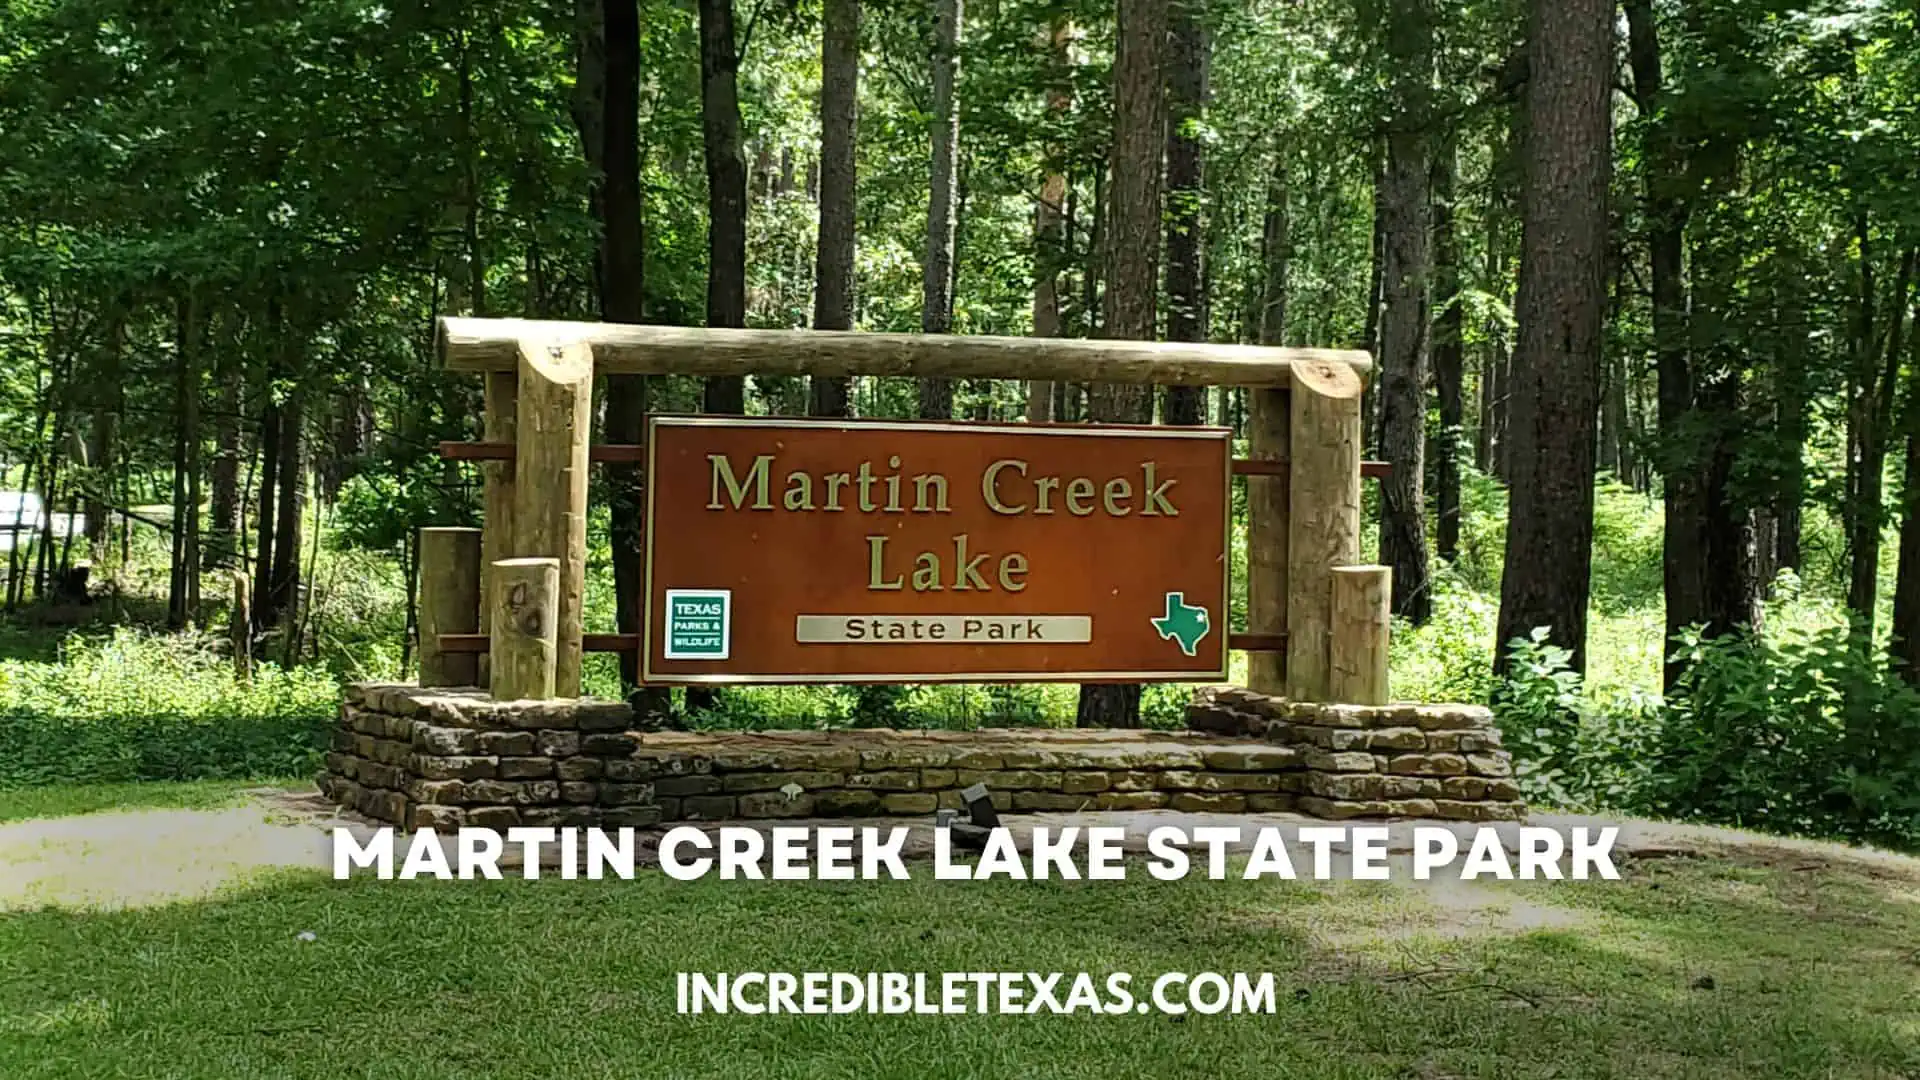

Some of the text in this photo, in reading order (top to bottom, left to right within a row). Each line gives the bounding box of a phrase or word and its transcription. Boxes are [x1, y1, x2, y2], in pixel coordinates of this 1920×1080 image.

[705, 453, 1180, 517] Martin Creek
[866, 533, 1030, 592] Lake
[675, 603, 721, 615] TEXAS
[674, 621, 709, 631] PARKS
[845, 618, 1044, 640] State Park
